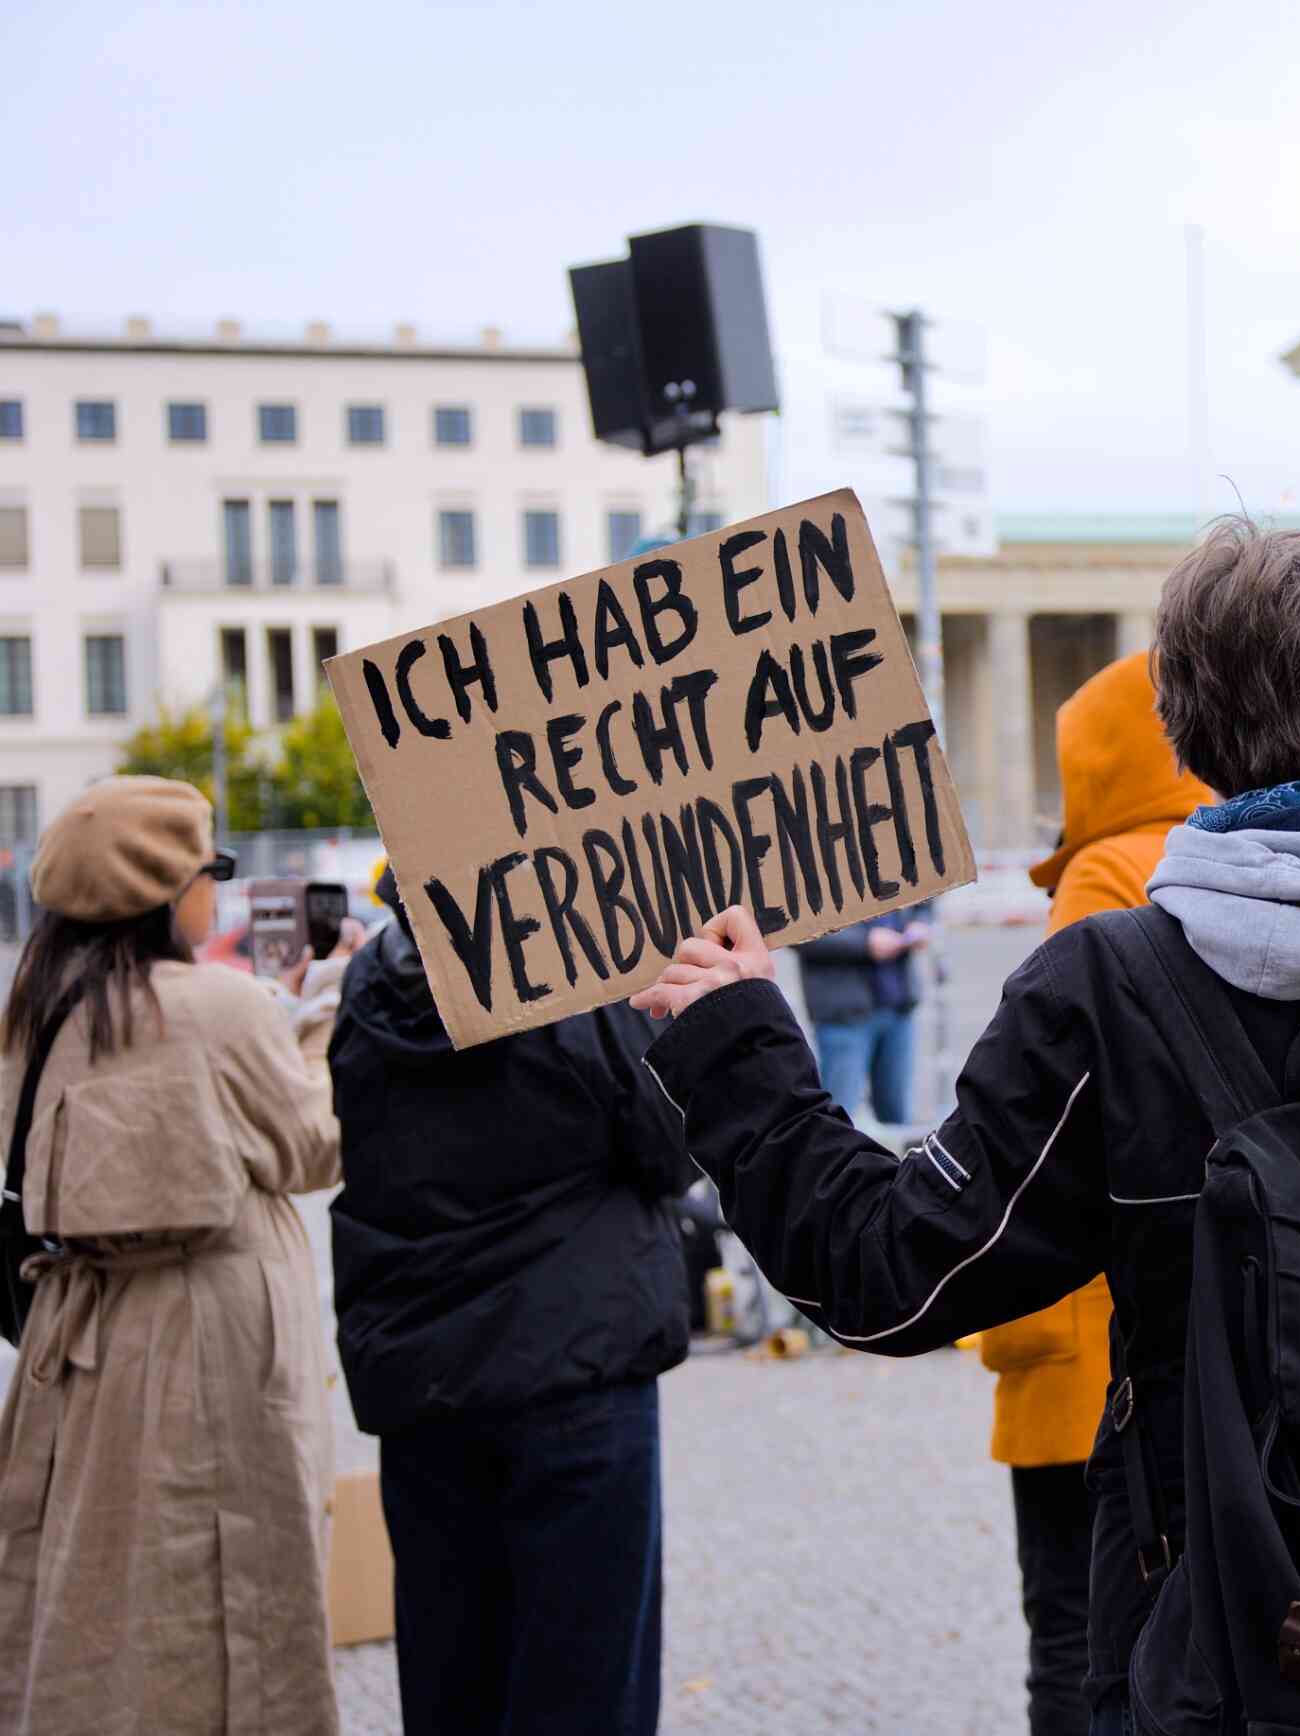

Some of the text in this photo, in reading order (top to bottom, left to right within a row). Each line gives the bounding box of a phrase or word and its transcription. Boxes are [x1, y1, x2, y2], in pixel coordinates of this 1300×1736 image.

[361, 511, 856, 750] ICH HAB EIN
[494, 627, 885, 839] RECHT AUF
[423, 718, 947, 1014] VERBUNDENHEIT
